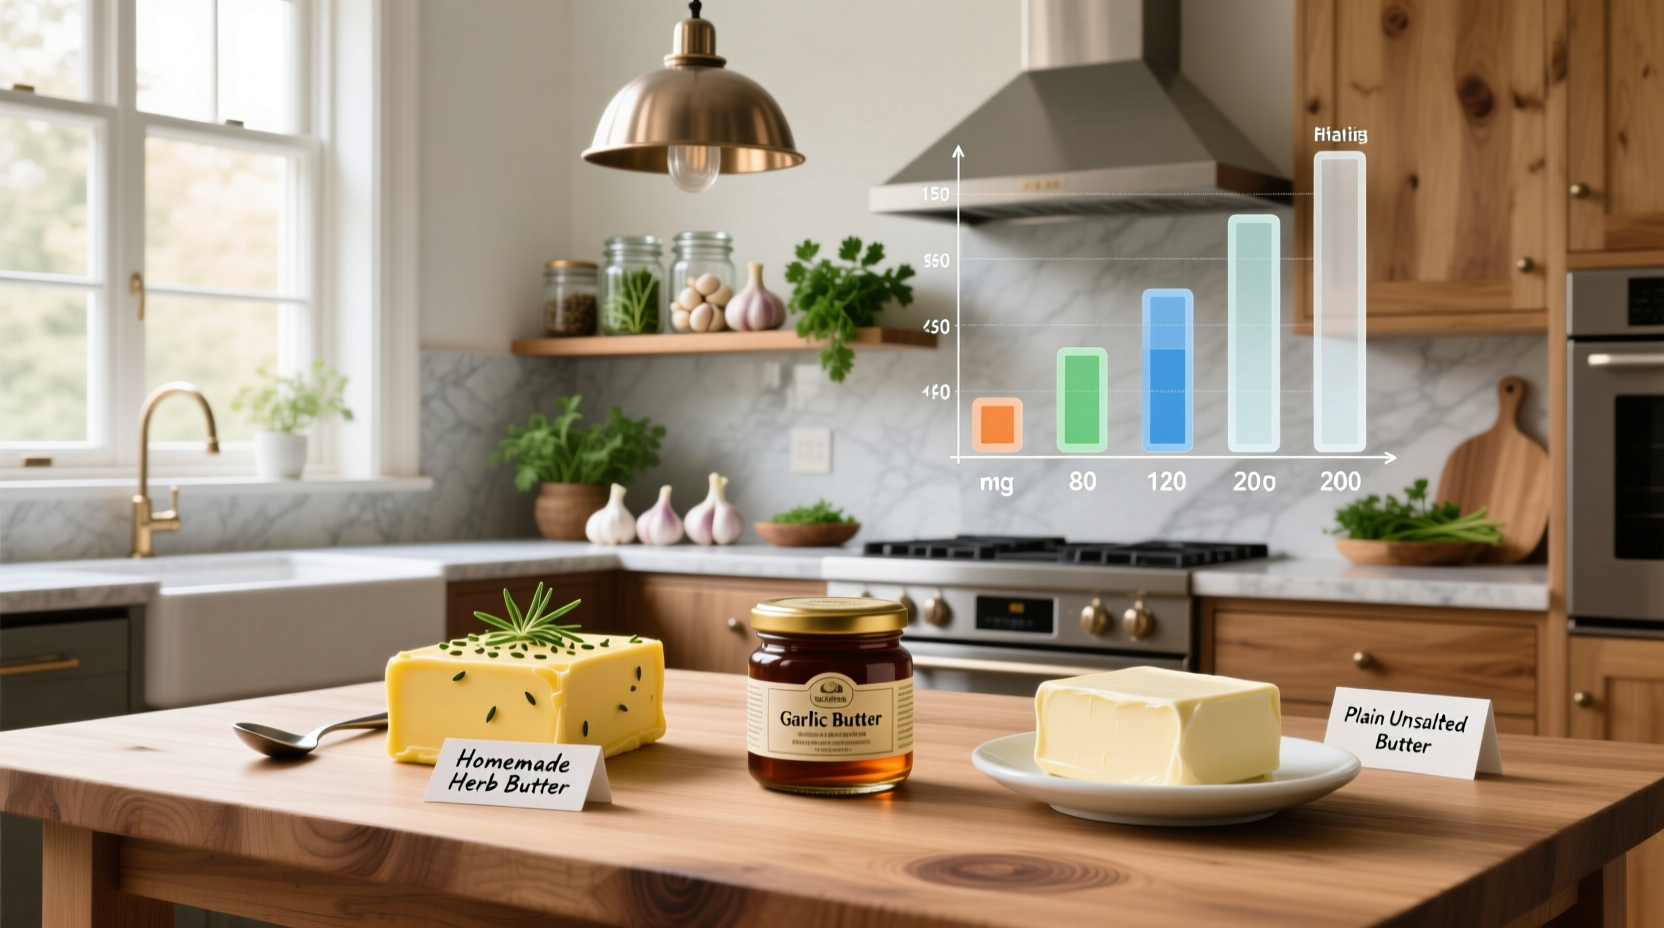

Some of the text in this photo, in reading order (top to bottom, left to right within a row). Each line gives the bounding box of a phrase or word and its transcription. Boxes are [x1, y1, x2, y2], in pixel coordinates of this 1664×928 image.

[780, 711, 882, 727] Garlic Butter
[1344, 706, 1469, 733] Plain Unsalted
[1375, 733, 1432, 754] Butter
[455, 748, 570, 773] Homemade
[448, 772, 570, 795] Herb Butter
